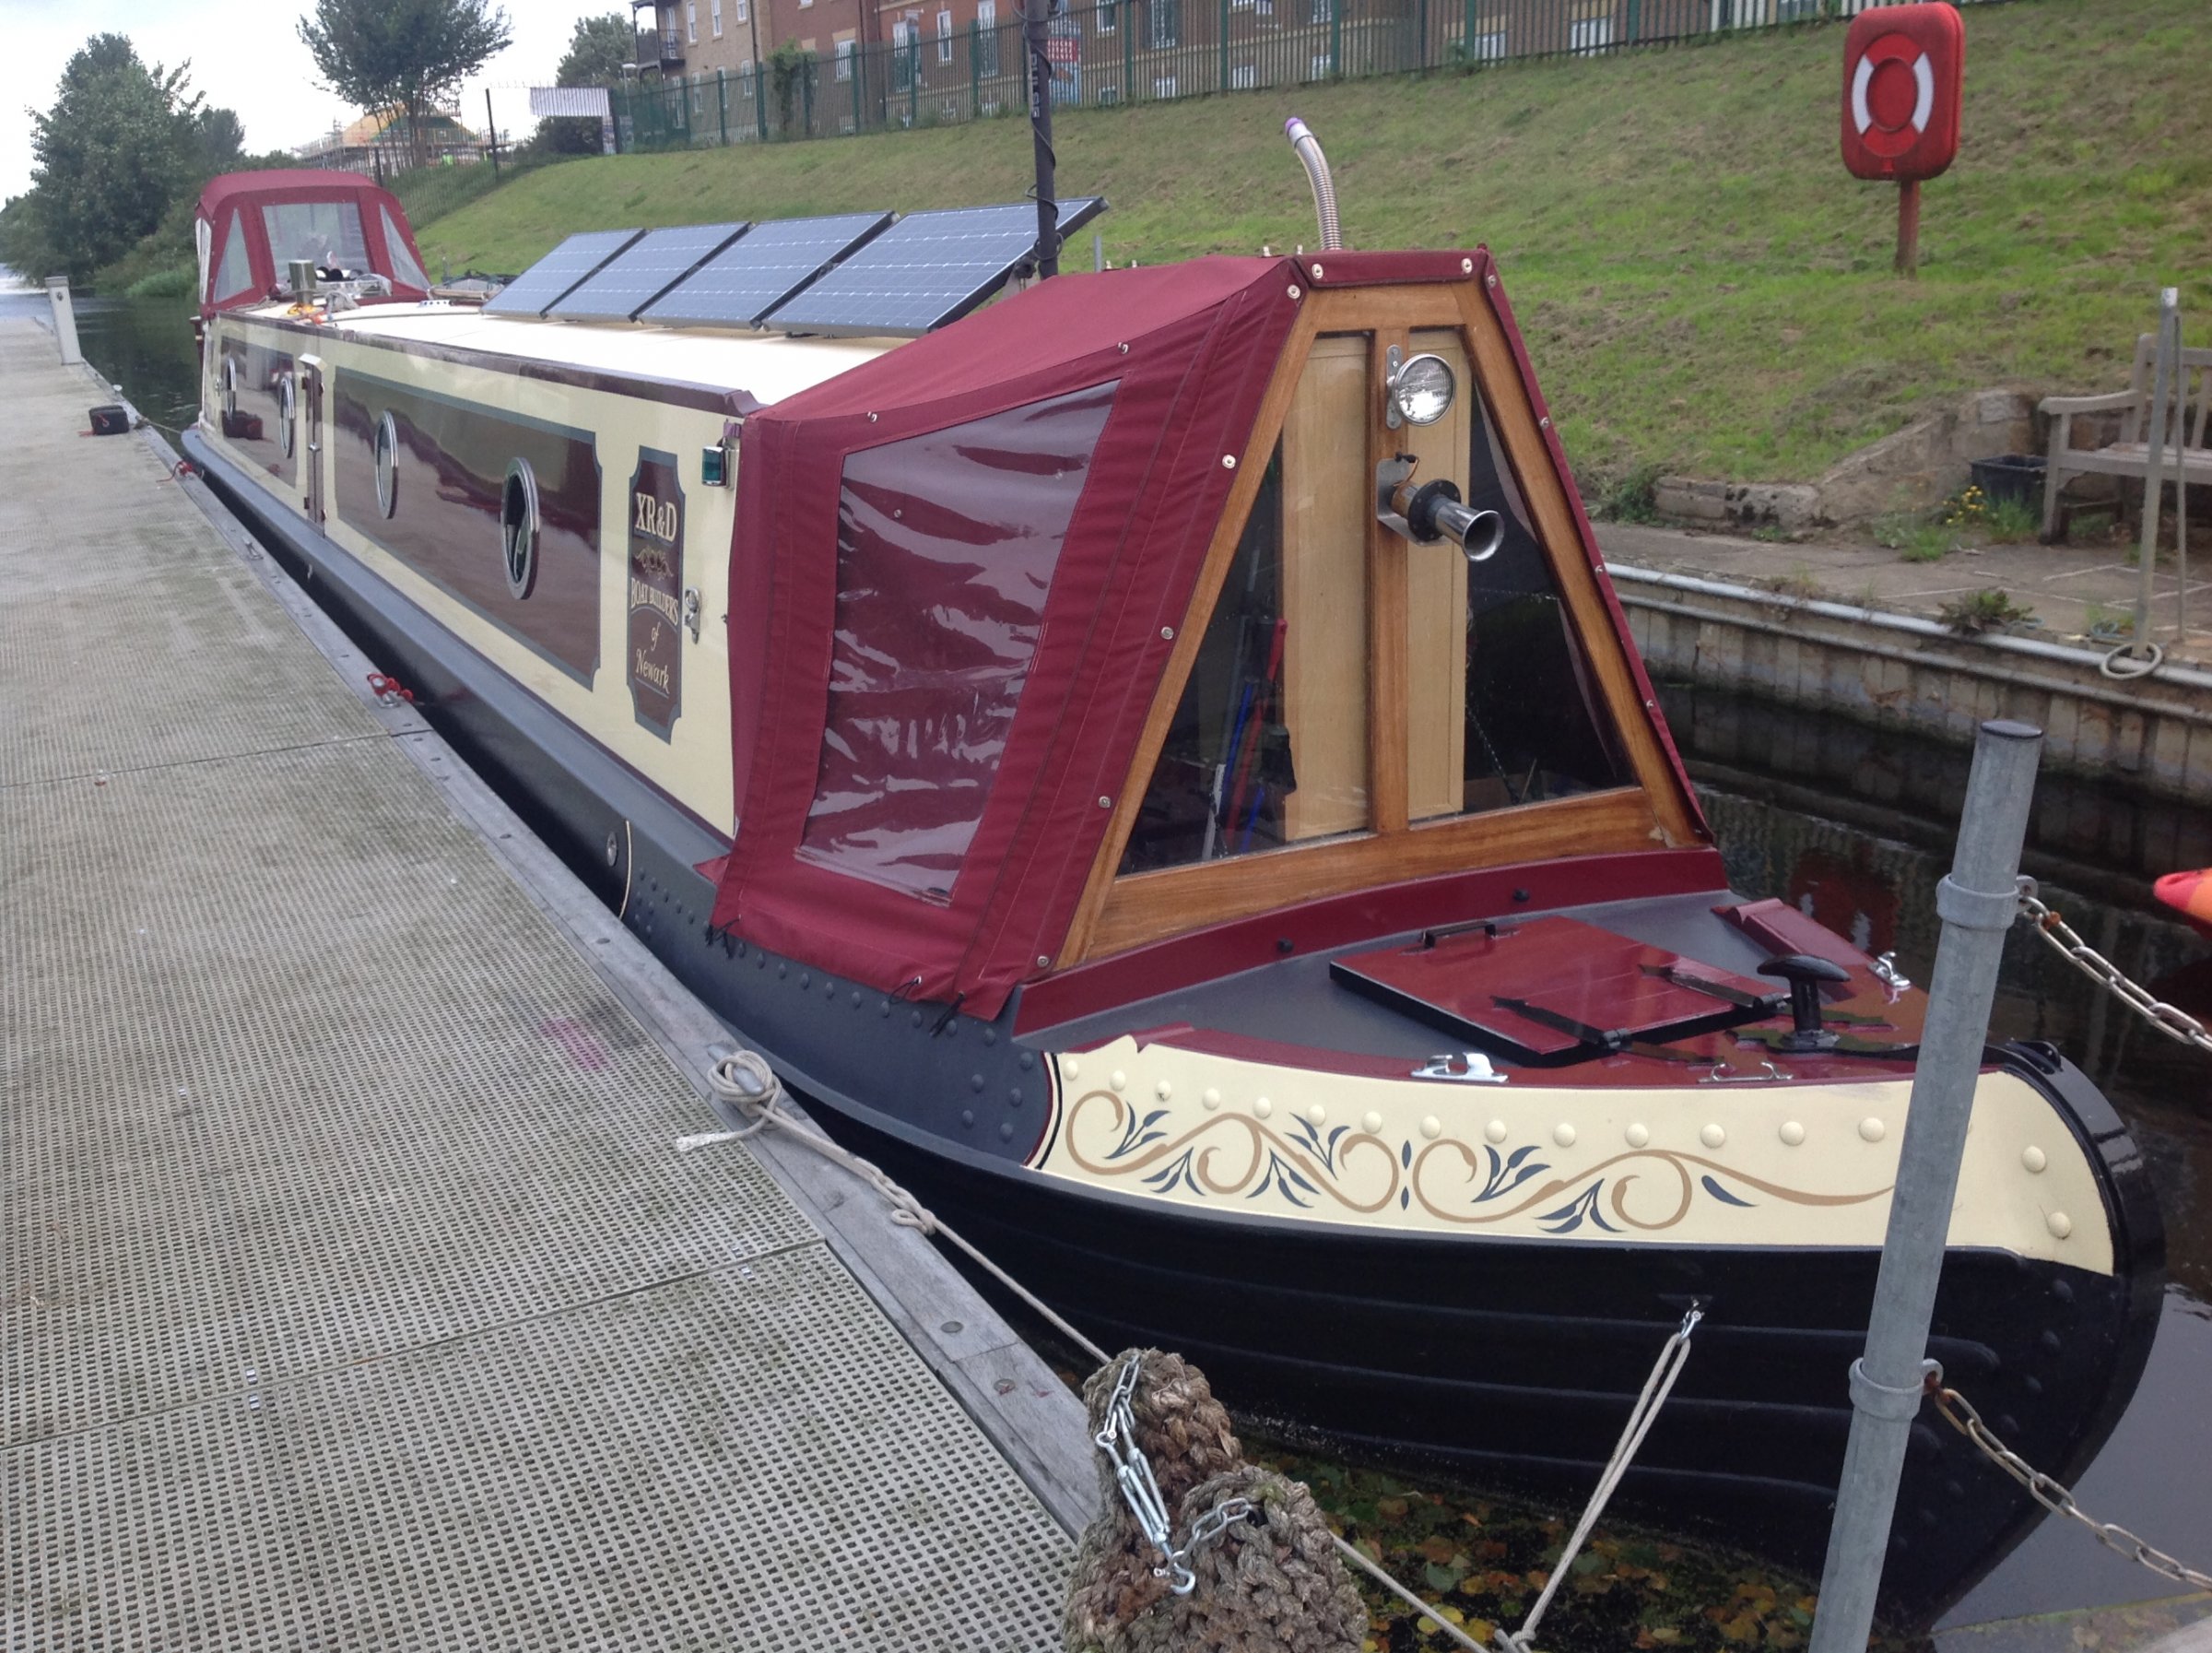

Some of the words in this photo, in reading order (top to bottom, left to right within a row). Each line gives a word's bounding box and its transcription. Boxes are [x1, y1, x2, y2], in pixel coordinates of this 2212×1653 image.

[635, 491, 677, 542] XR&D
[631, 577, 648, 608] BOAT
[649, 586, 678, 626] BUILDERS
[651, 621, 661, 652] of
[636, 648, 670, 694] Newark
